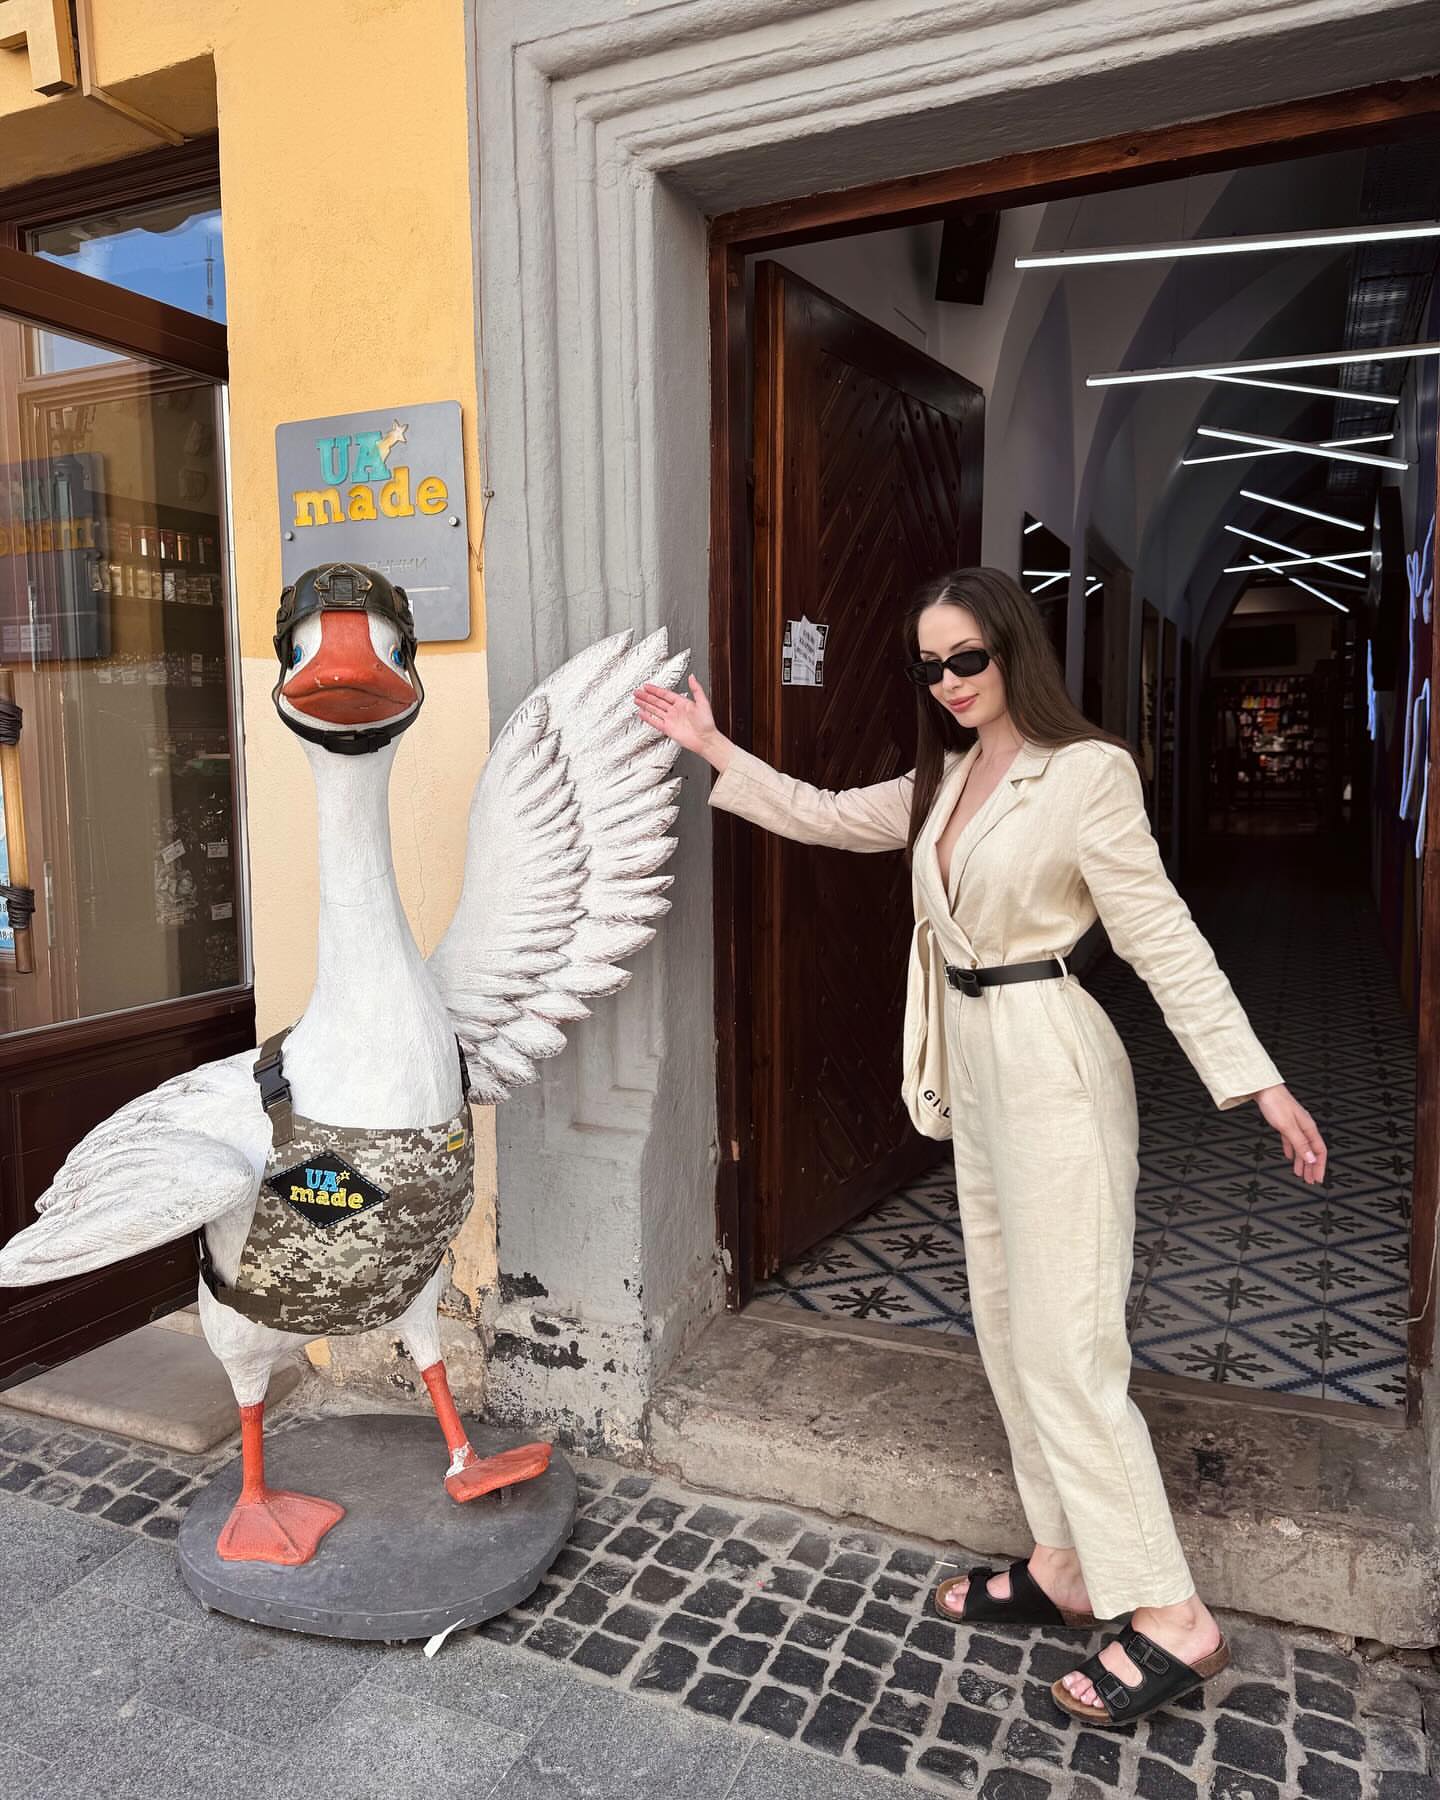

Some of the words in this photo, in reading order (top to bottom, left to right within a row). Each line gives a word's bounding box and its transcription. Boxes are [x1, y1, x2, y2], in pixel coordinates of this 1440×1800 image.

[316, 431, 392, 485] UA
[292, 466, 448, 527] made
[290, 1185, 364, 1209] made
[305, 1168, 339, 1192] UA
